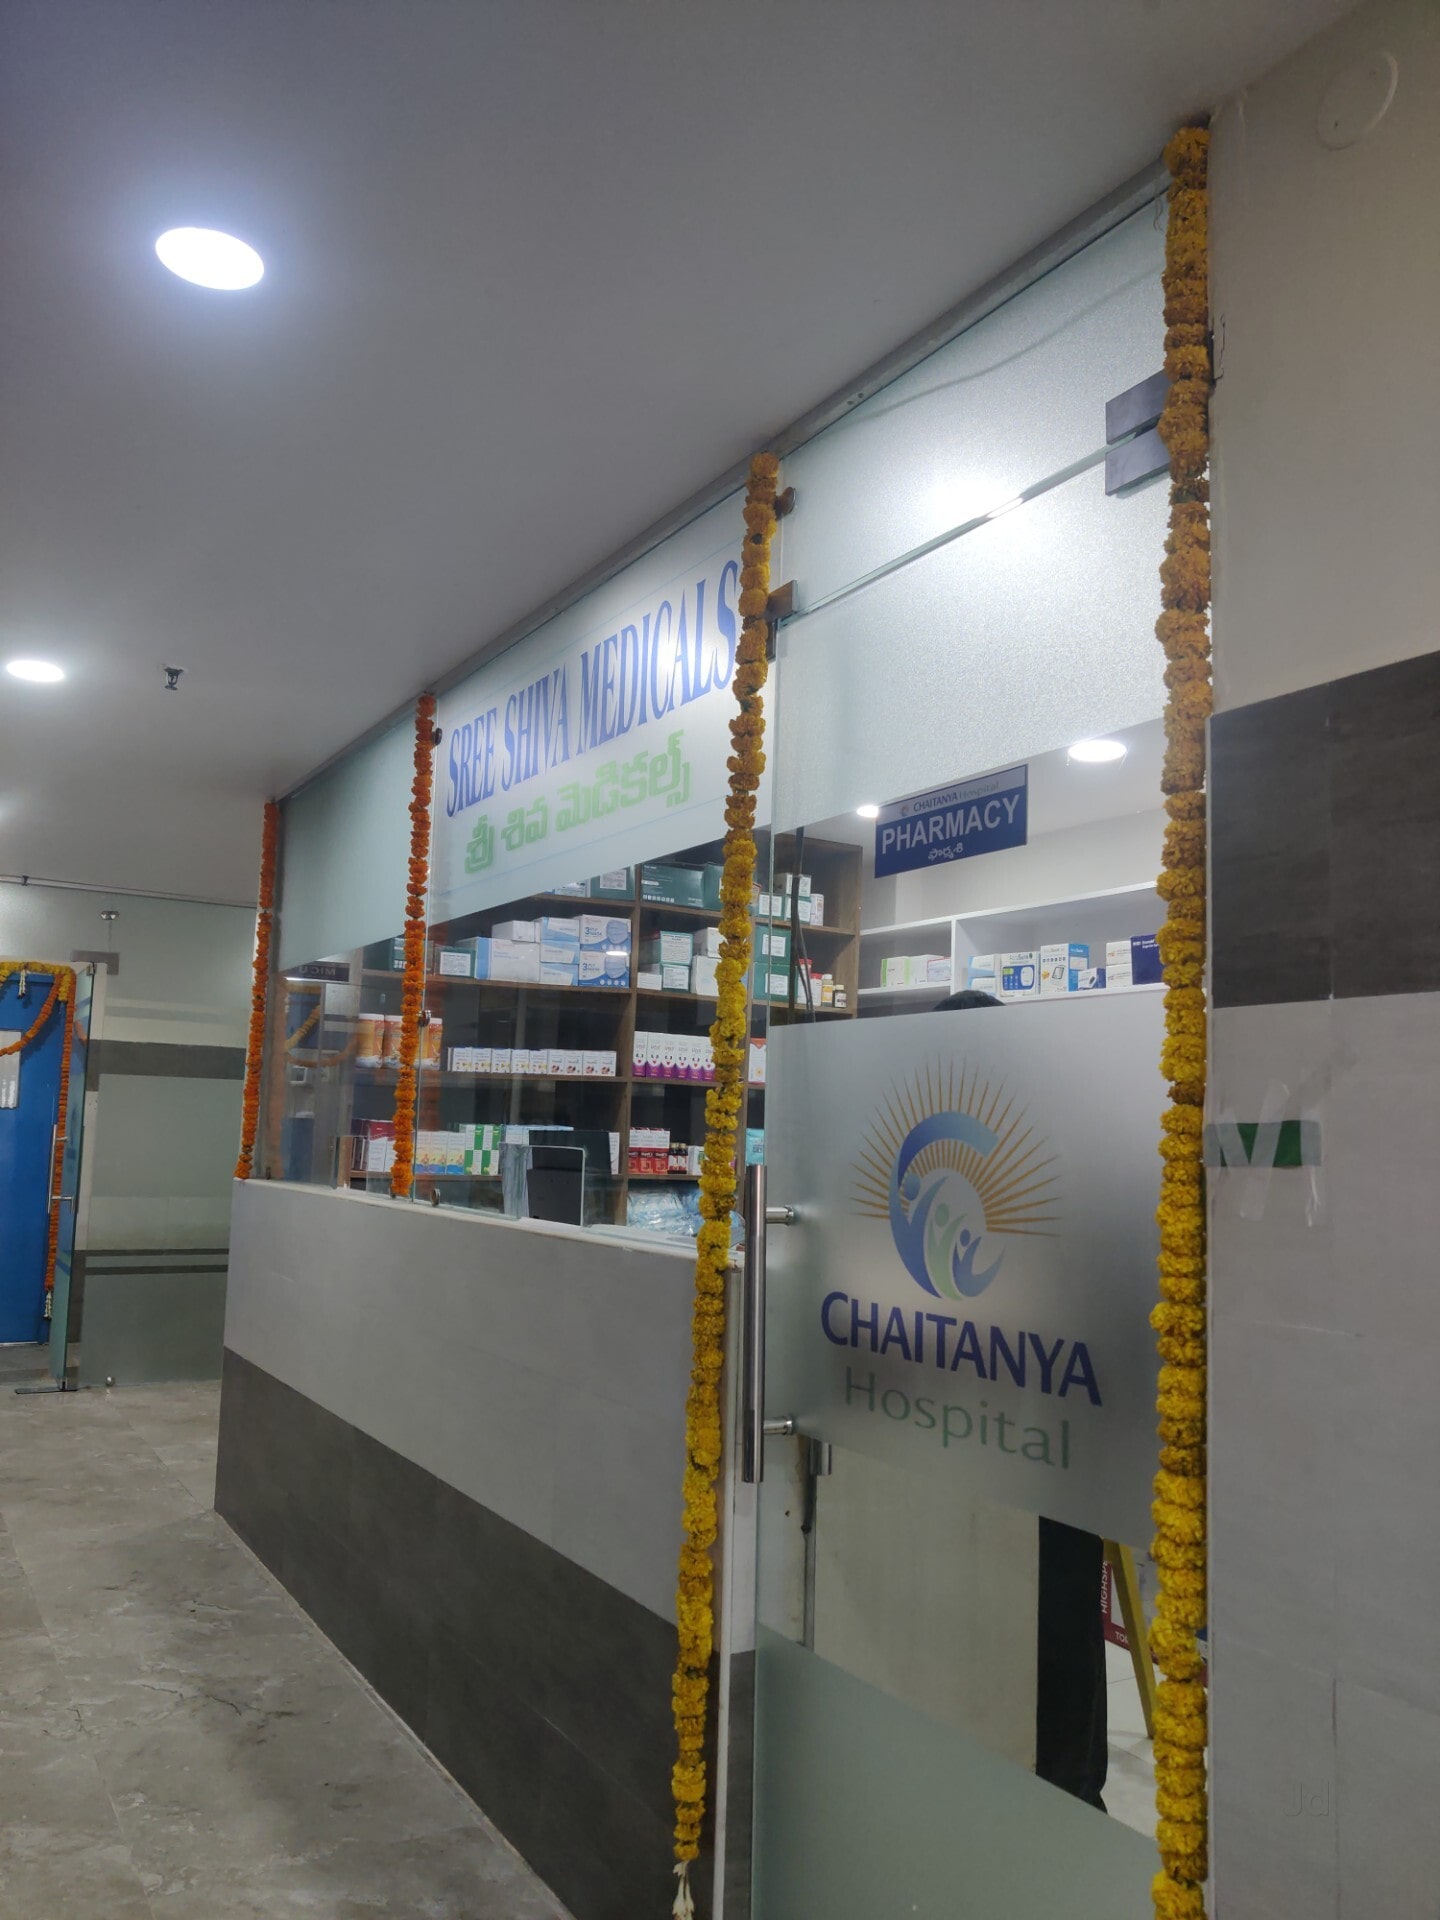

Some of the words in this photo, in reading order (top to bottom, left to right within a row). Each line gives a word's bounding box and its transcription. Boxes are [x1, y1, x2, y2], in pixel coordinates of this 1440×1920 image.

[446, 707, 498, 818] SREE
[501, 662, 570, 792] SHIVA
[576, 559, 738, 754] MEDICALS
[464, 814, 495, 875] శ్రీ
[501, 796, 548, 852] శివ
[881, 795, 1020, 855] PHARMACY
[913, 792, 958, 812] CHAITANYA
[959, 781, 999, 799] Hospital
[821, 1291, 1103, 1407] CHAITANYA
[845, 1366, 1070, 1470] Hospital
